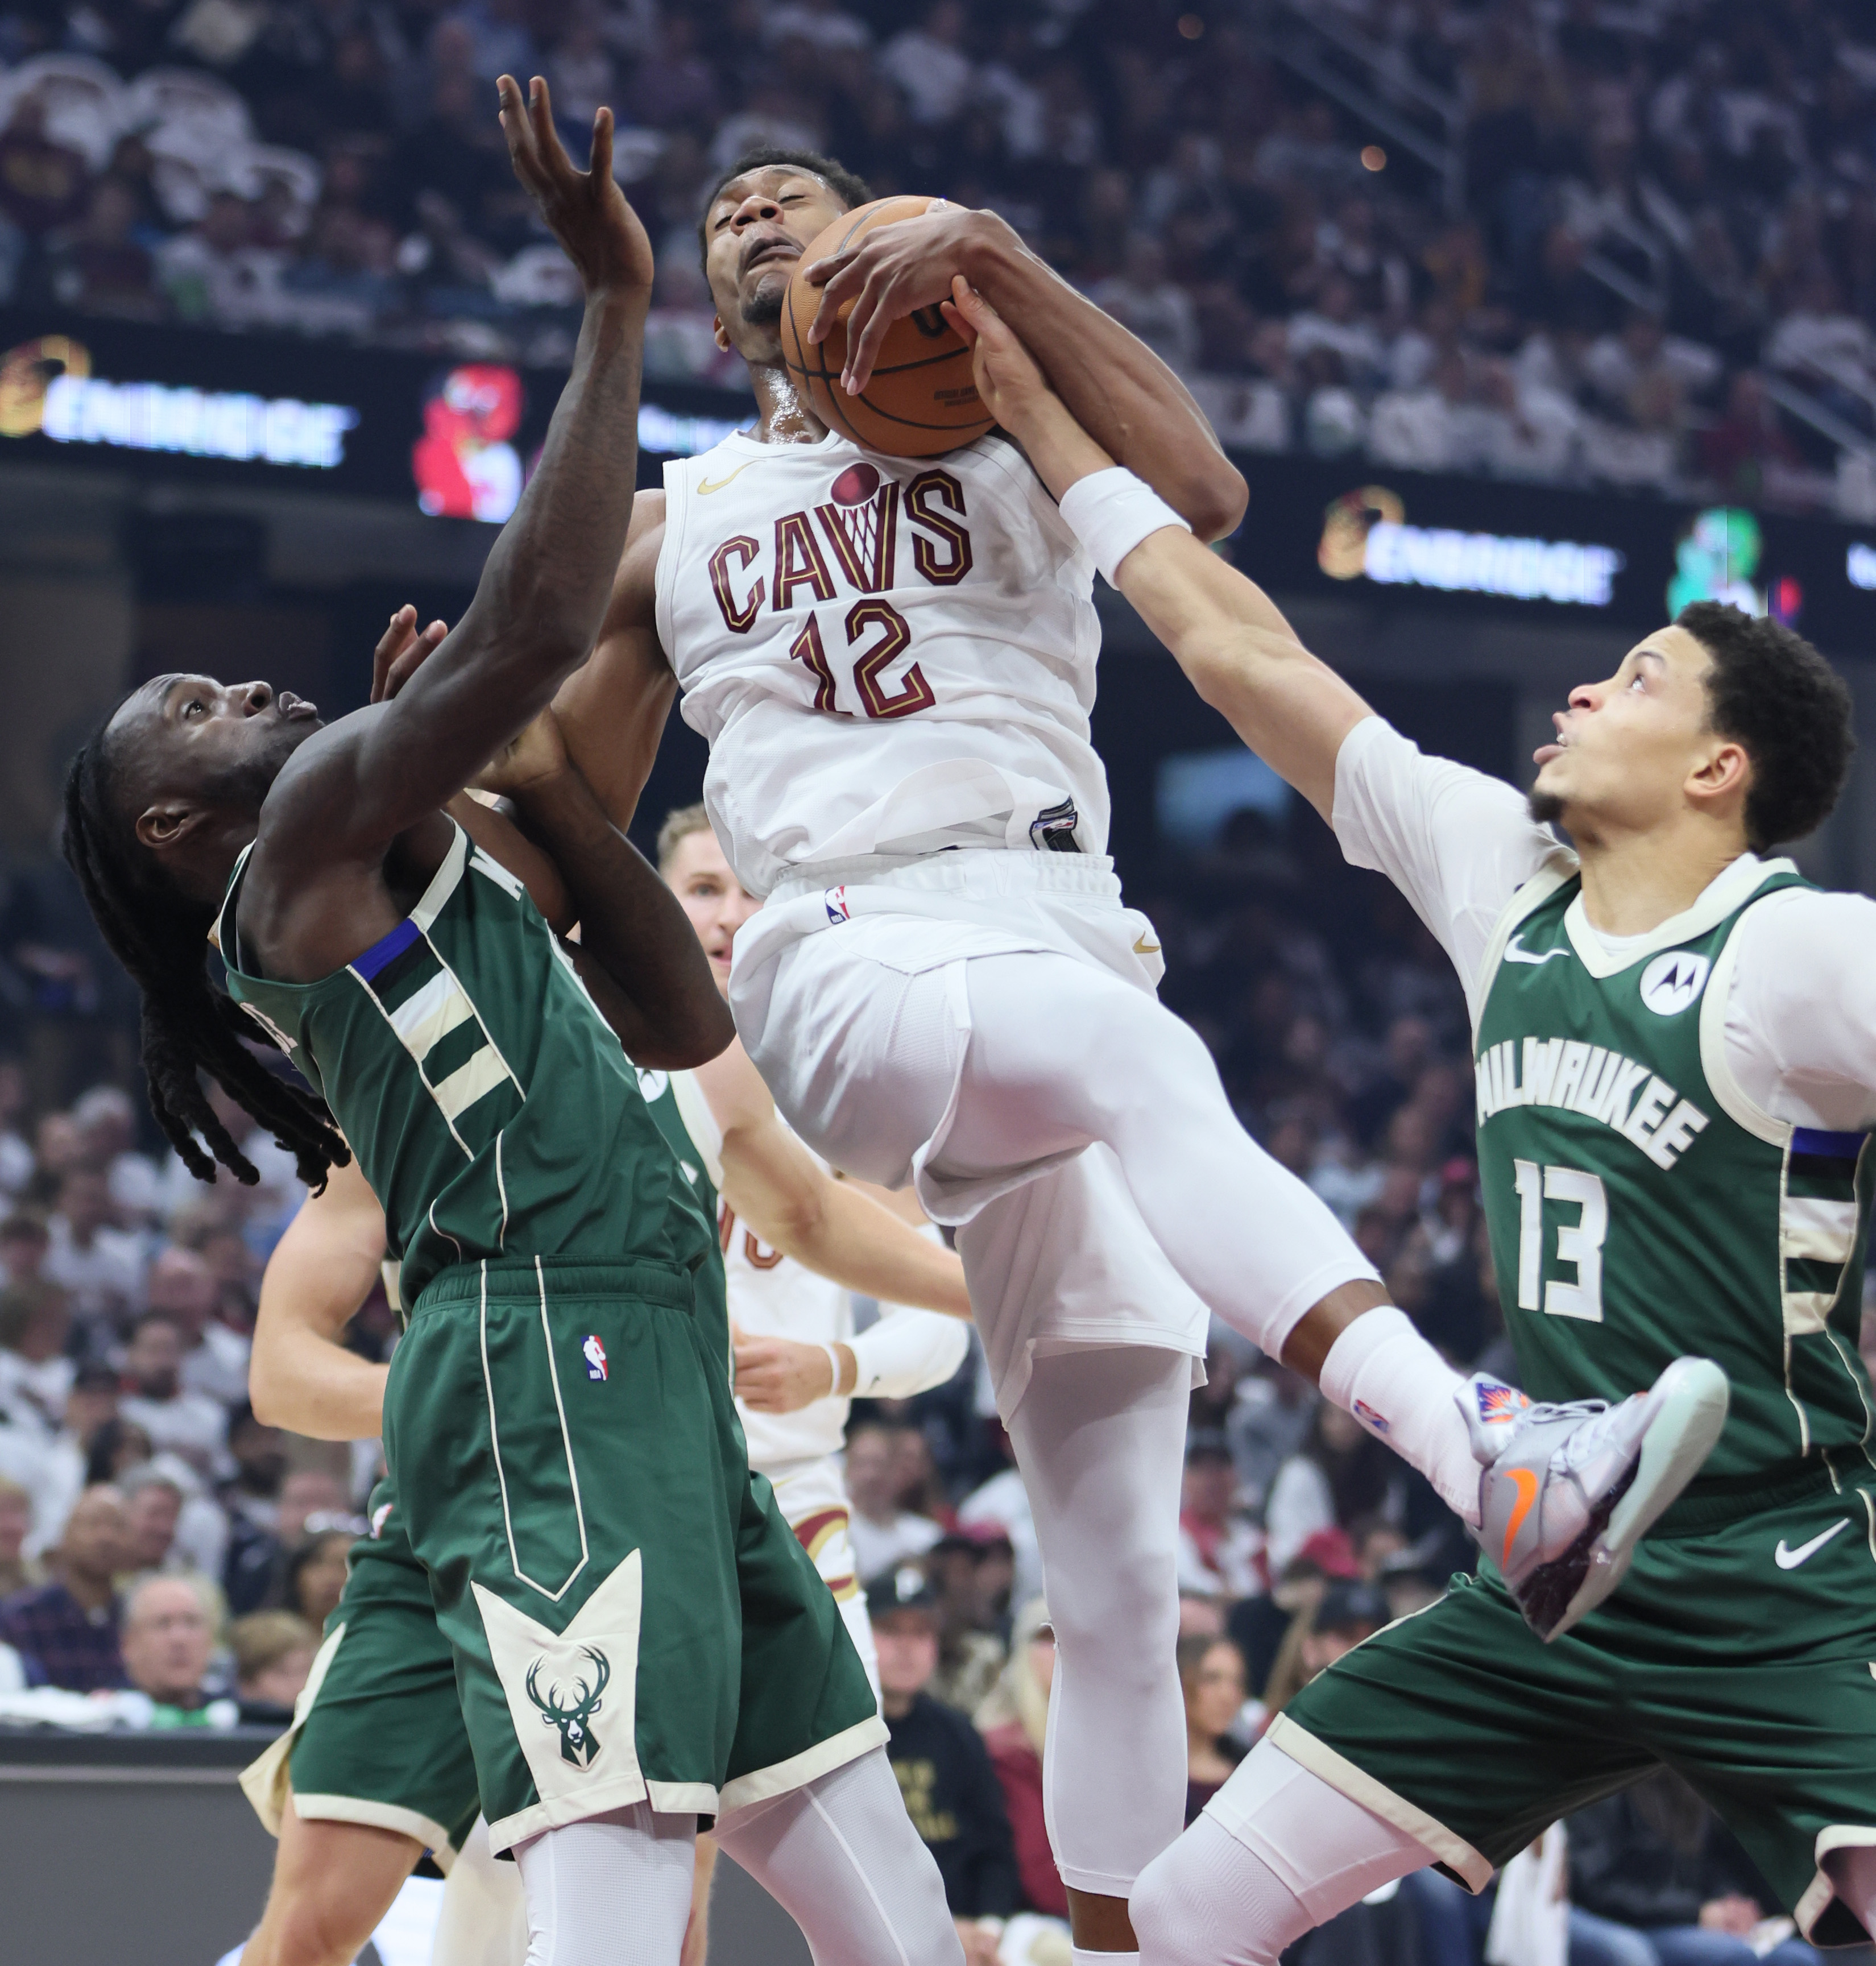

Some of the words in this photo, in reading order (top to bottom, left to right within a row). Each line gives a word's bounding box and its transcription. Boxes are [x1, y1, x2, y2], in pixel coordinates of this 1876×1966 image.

[707, 467, 974, 634] CAVS
[789, 598, 937, 719] 12
[1513, 1158, 1609, 1323] 13
[589, 1369, 602, 1380] NBA
